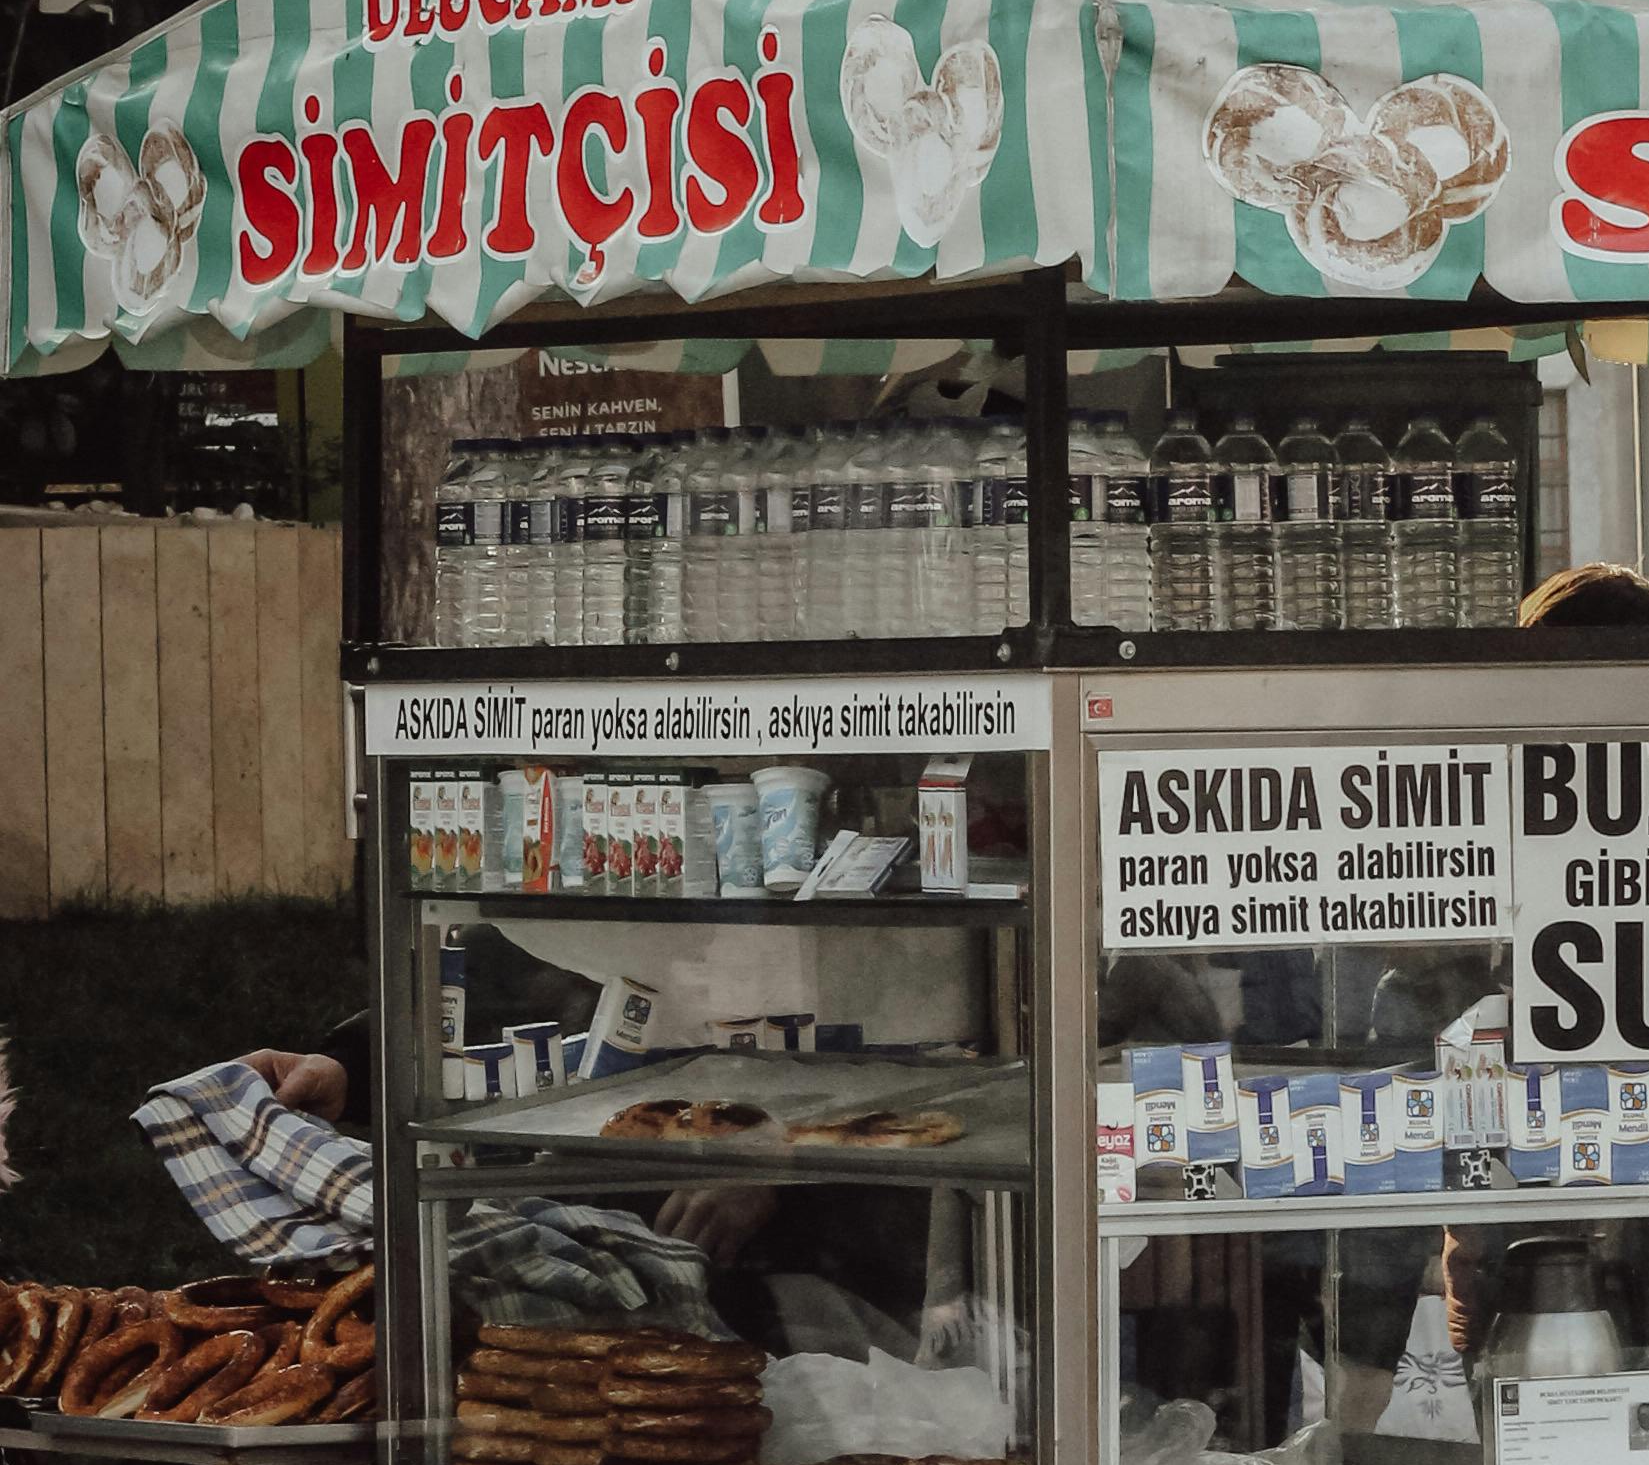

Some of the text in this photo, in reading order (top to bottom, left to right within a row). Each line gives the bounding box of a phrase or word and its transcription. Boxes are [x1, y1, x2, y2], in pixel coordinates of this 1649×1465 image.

[238, 32, 805, 285] SİMİTÇİSİ
[532, 397, 663, 420] SENİN KAHVEN,
[1168, 497, 1212, 506] aroma
[396, 697, 468, 740] ASKIDA
[474, 686, 526, 740] SİMİT
[532, 706, 584, 750] paran
[591, 697, 648, 751] yoksa
[654, 695, 750, 740] alabilirsin
[768, 694, 834, 750] askıya
[840, 692, 891, 738] simit
[897, 689, 1016, 737] takabilirsin
[1118, 748, 1492, 835] ASKIDA SİMİT
[1119, 839, 1496, 892] paran yoksa alabilirsin
[1120, 889, 1497, 940] askıya simit takabilirsin
[1097, 1133, 1132, 1150] eyaz
